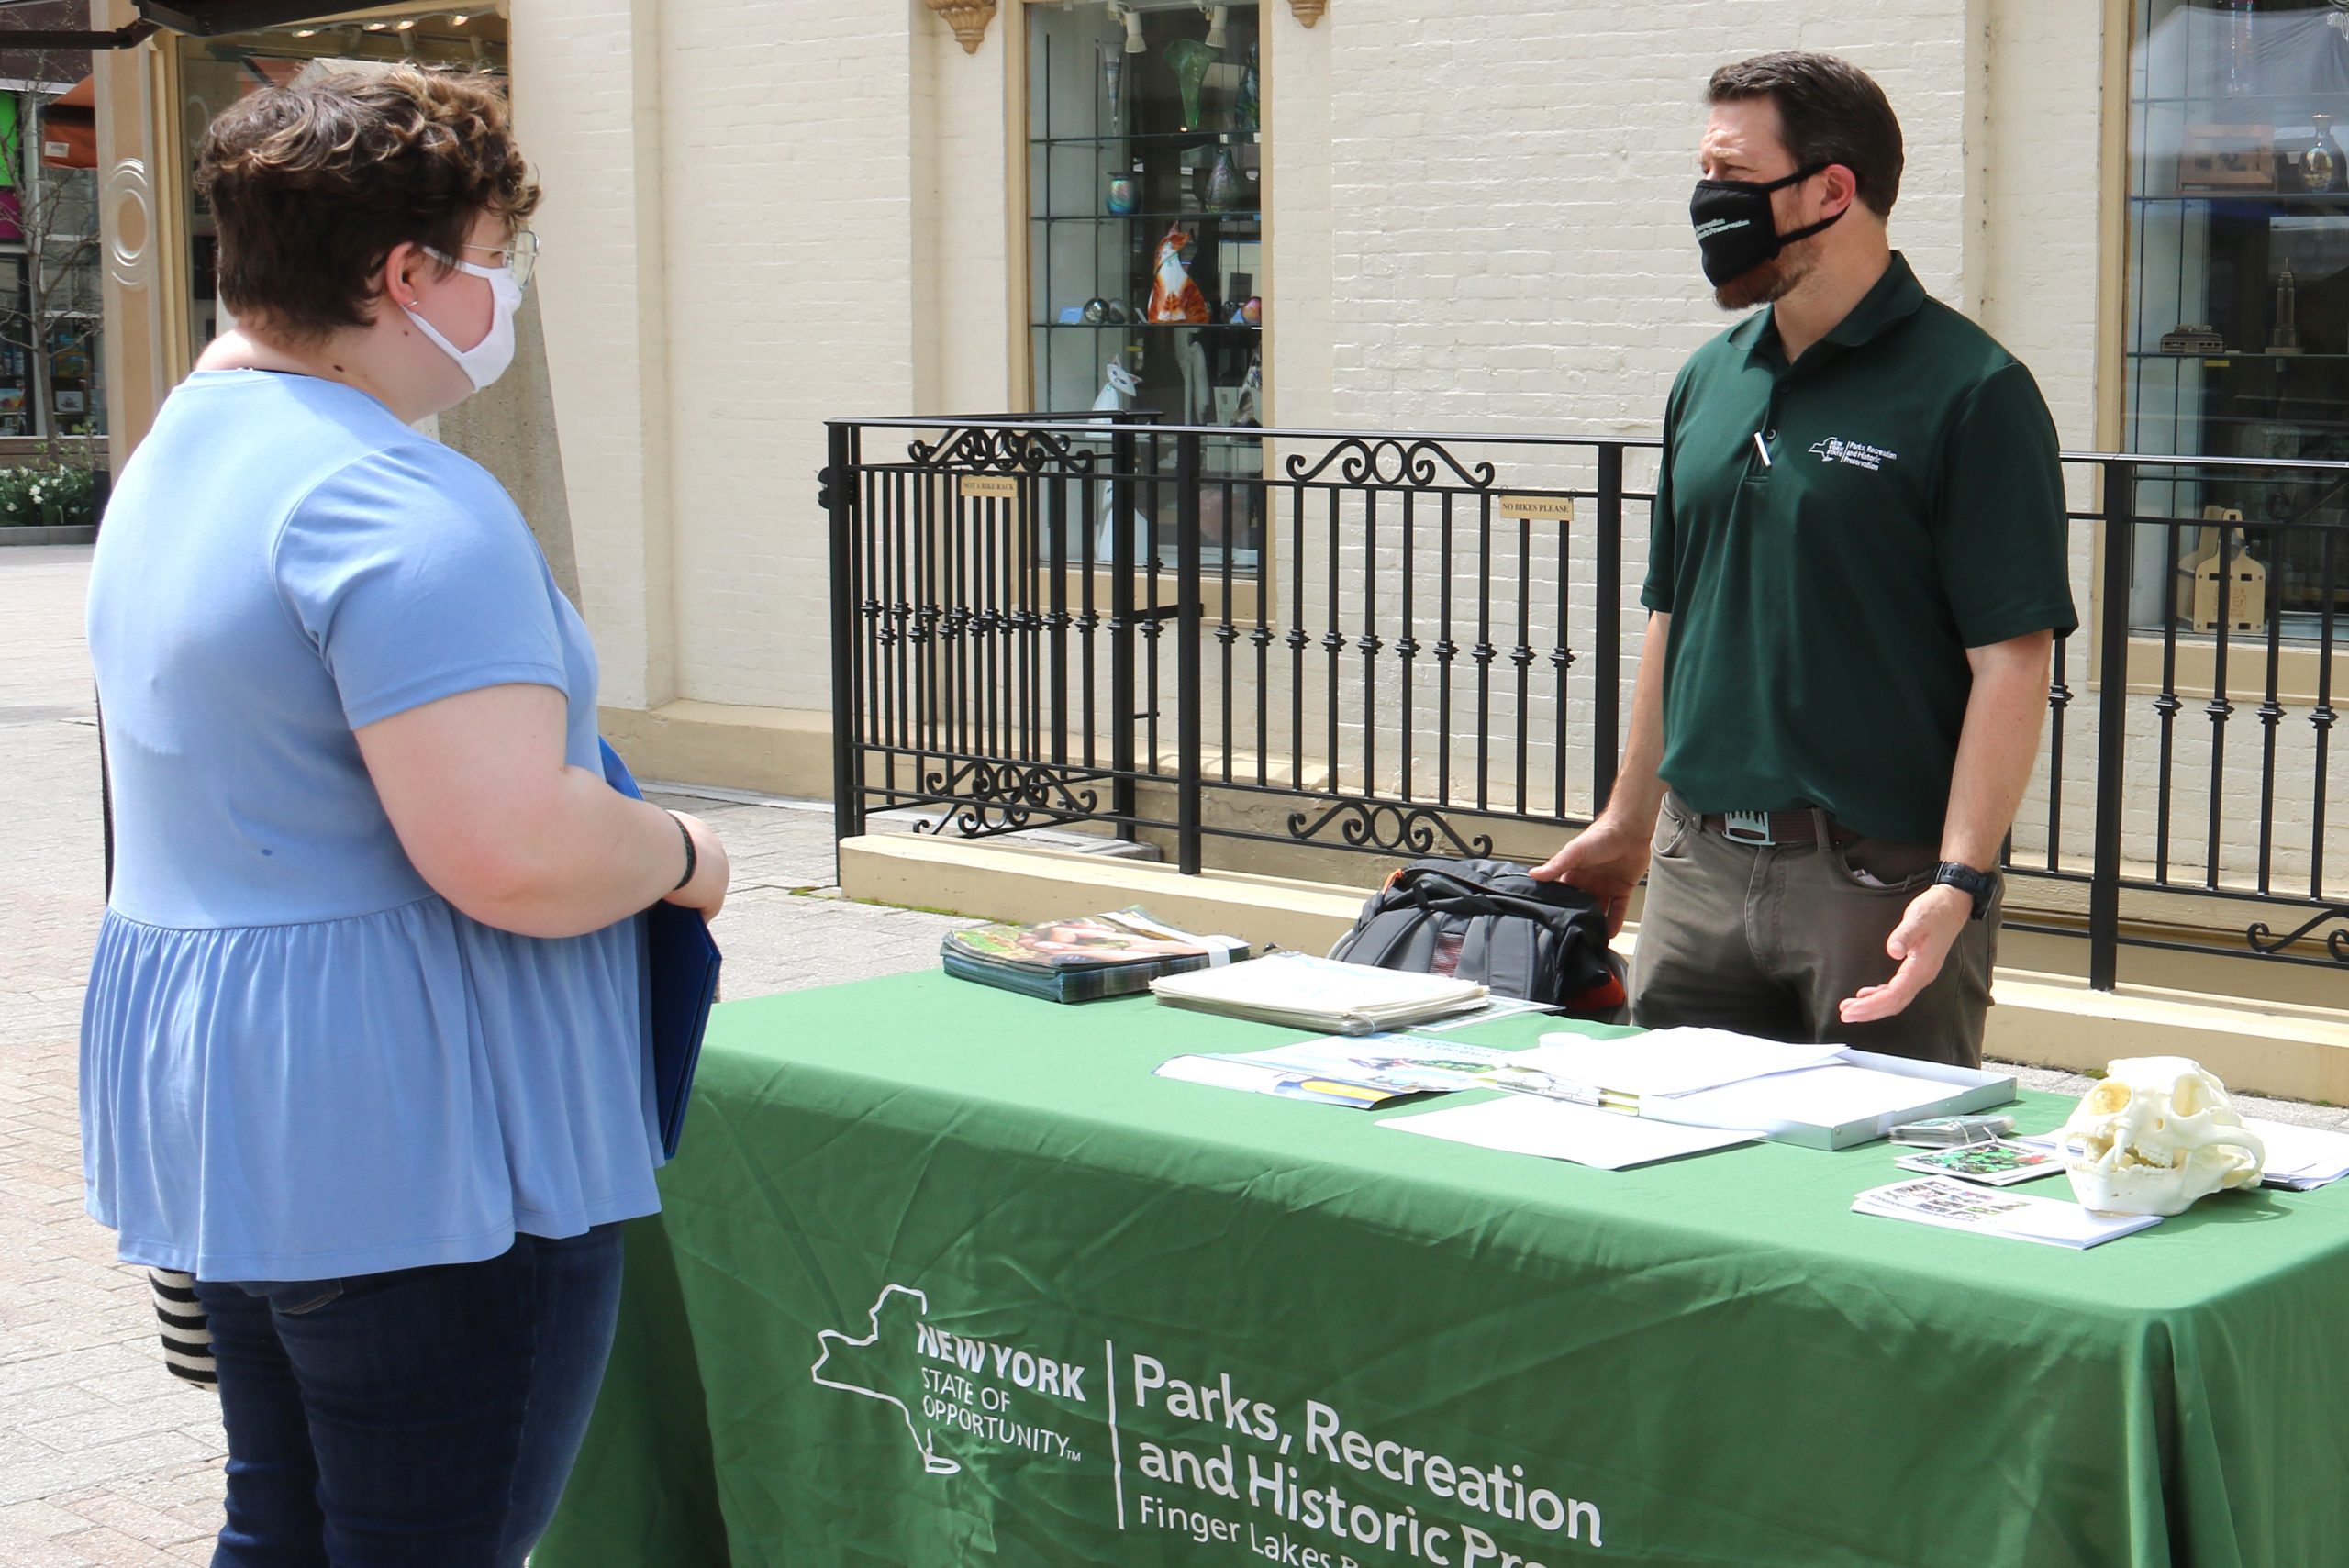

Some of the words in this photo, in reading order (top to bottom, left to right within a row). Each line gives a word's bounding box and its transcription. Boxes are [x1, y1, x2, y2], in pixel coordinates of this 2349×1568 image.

[1843, 456, 1879, 471] Preservation
[1846, 450, 1858, 458] and
[1857, 450, 1881, 463] Historic
[1866, 445, 1898, 460] Recreation
[1502, 503, 1514, 511] NO
[1515, 504, 1538, 512] BIKES
[1539, 505, 1569, 513] PLEASE
[916, 1321, 985, 1373] NEW
[989, 1343, 1086, 1402] YORK
[921, 1366, 974, 1406] STATE
[980, 1387, 1011, 1412] OF
[922, 1395, 1070, 1457] OPPORTUNITY
[1133, 1353, 1292, 1455] Parks,
[1305, 1399, 1602, 1548] Recreation
[1139, 1442, 1240, 1500] and
[1248, 1454, 1450, 1566] Historic
[1140, 1495, 1241, 1543] Finger
[1250, 1522, 1331, 1568] Lakes
